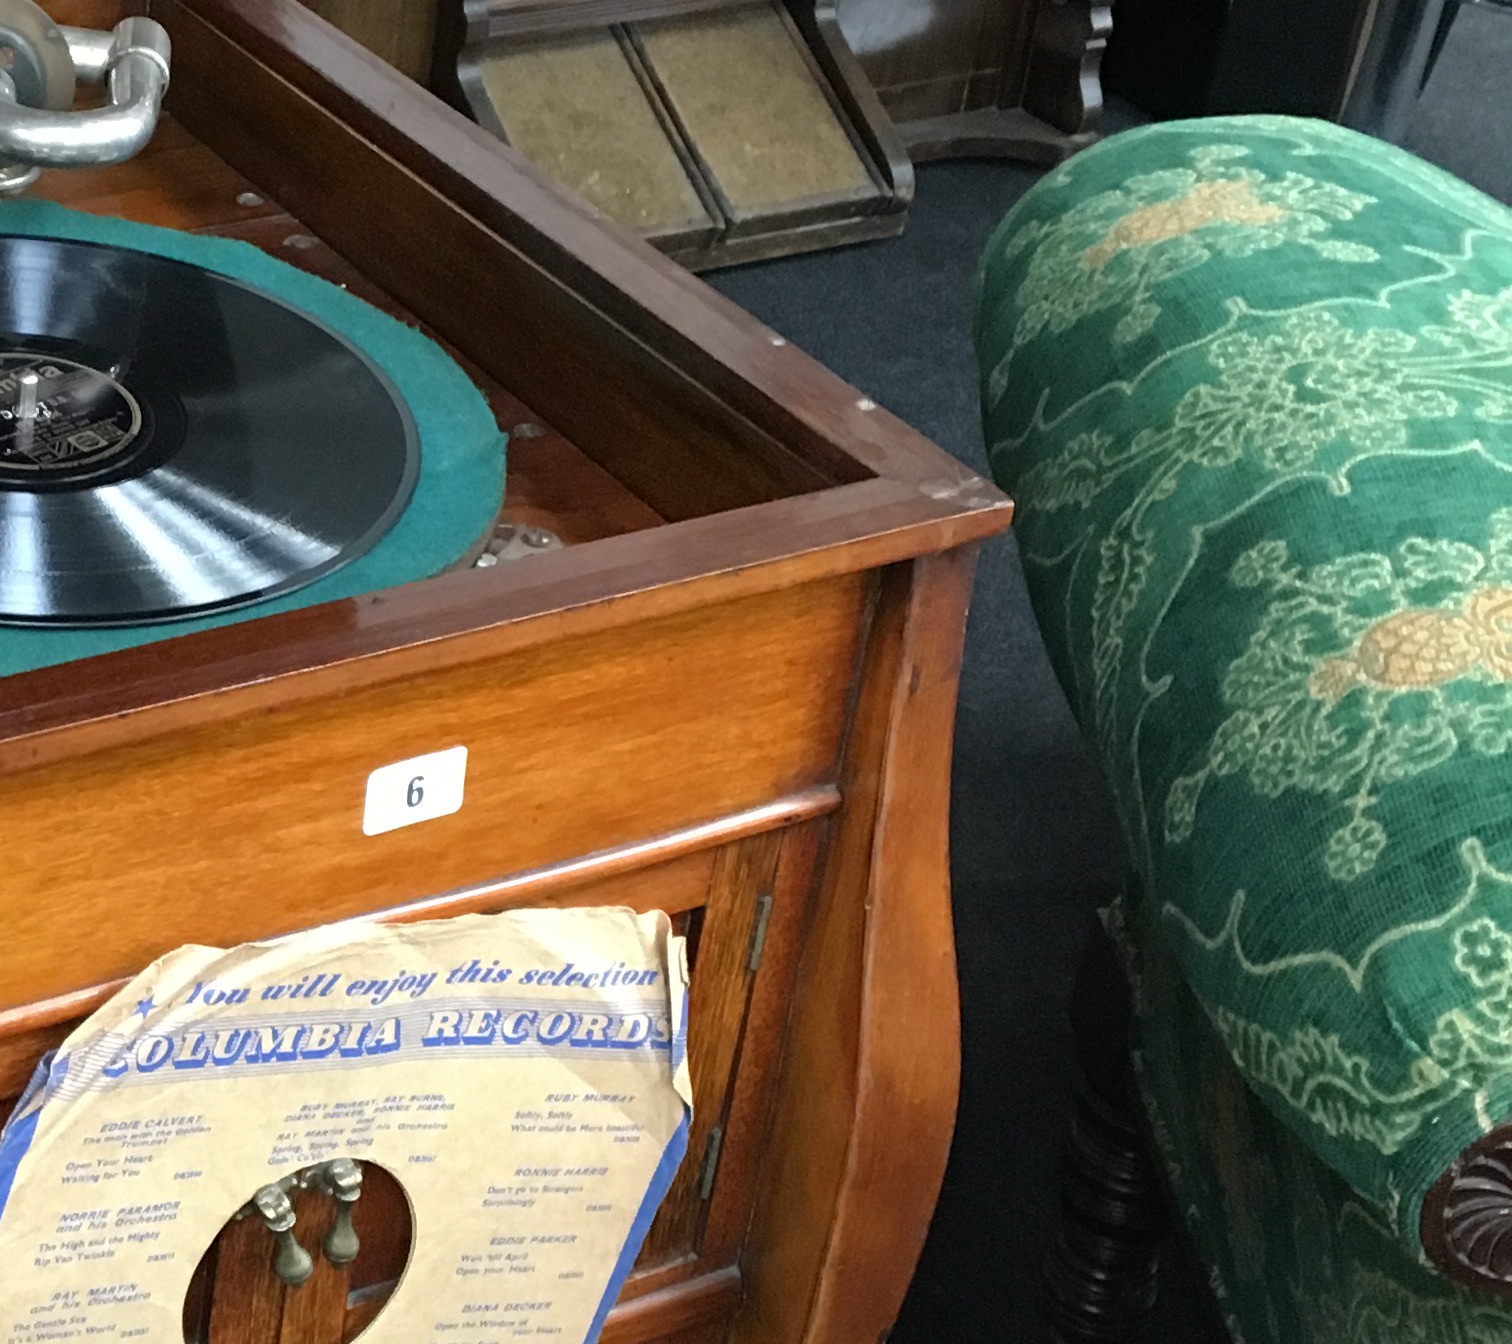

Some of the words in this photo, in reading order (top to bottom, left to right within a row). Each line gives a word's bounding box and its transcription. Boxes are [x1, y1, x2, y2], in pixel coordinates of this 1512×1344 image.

[406, 775, 425, 808] 6
[260, 973, 342, 1000] will
[345, 969, 438, 1005] enjoy
[445, 960, 513, 985] this
[518, 962, 660, 989] selection
[545, 1094, 577, 1102] RUBY
[100, 1121, 140, 1133] EDDIE
[145, 1115, 203, 1129] CALVERT
[66, 1162, 92, 1172] Open
[97, 1159, 120, 1167] Your
[125, 1155, 153, 1165] Heart
[59, 1209, 110, 1222] NORRIE
[117, 1201, 180, 1217] PARAMOR
[127, 1231, 160, 1244] Mighty
[52, 1291, 79, 1301] RAY
[88, 1283, 137, 1296] MARTIN
